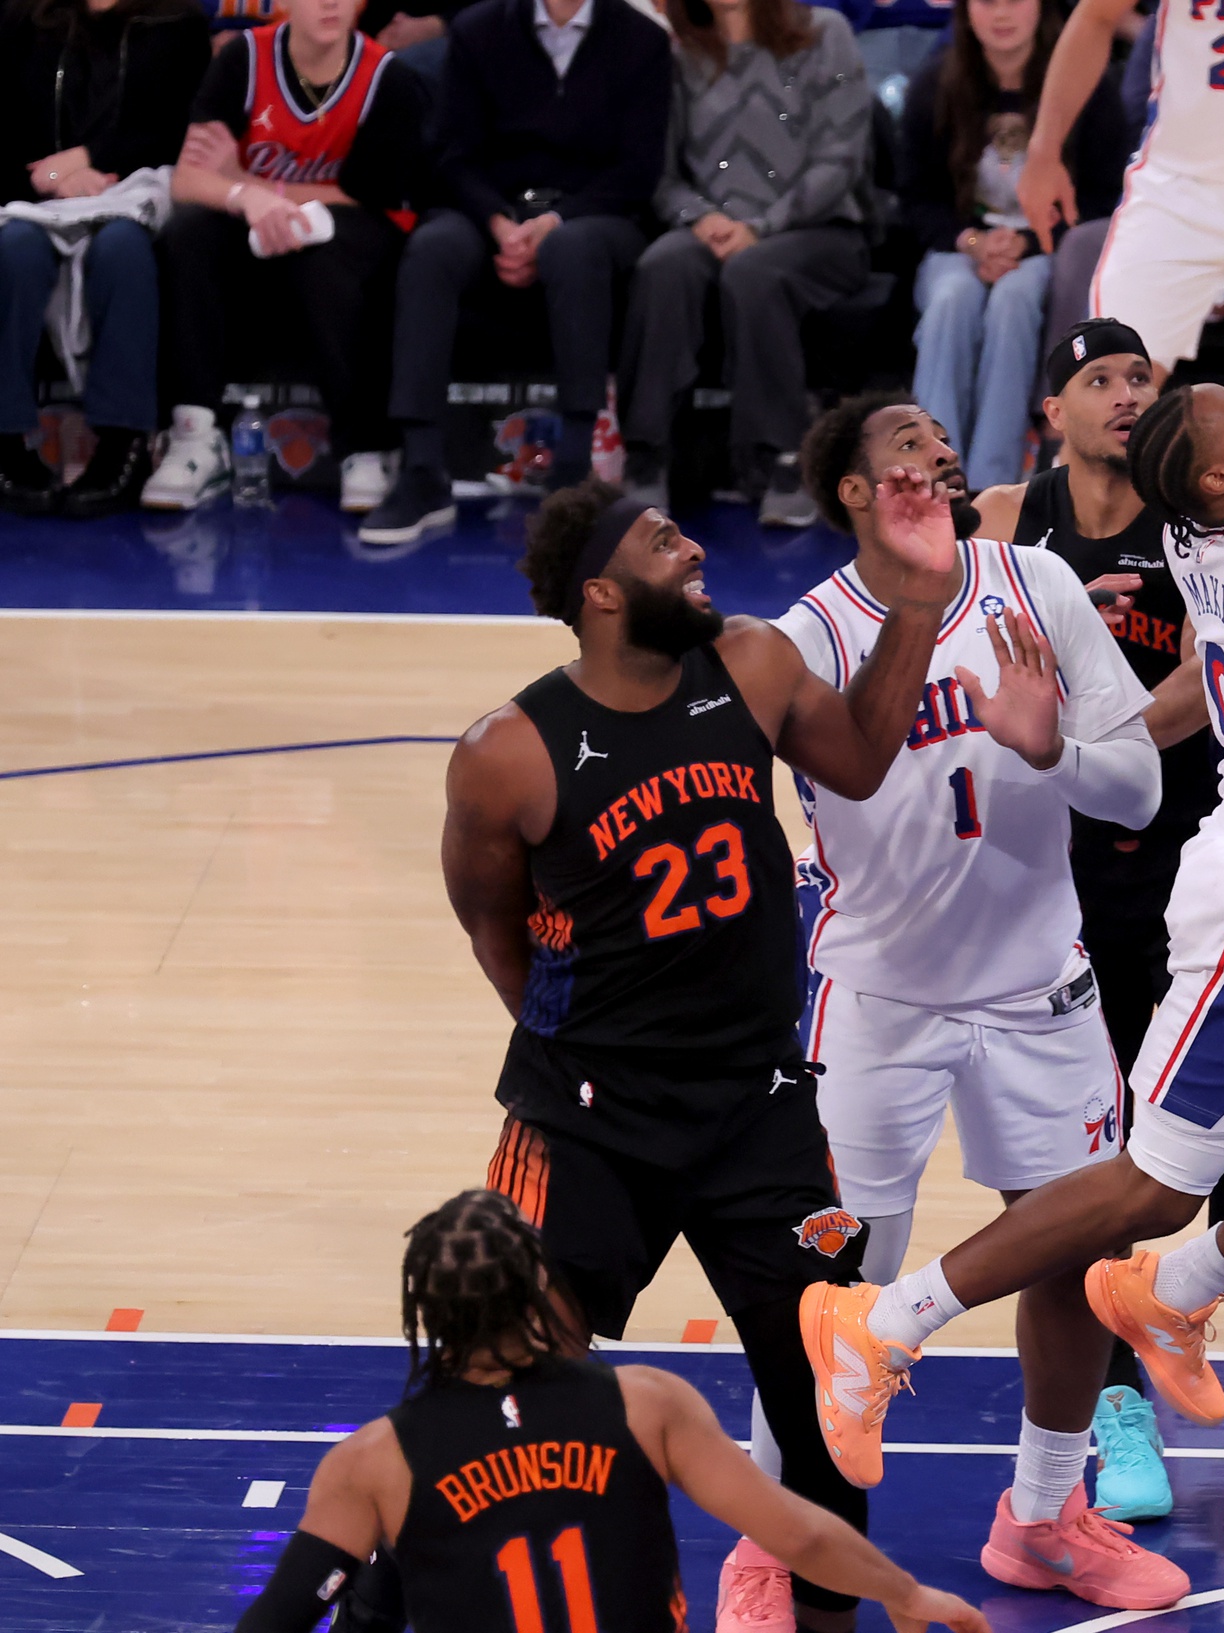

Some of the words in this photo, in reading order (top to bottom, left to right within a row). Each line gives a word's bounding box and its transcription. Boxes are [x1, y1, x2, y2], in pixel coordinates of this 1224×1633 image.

[589, 776, 664, 861] NEW
[662, 761, 761, 804] YORK
[949, 767, 982, 840] 1
[633, 820, 752, 940] 23
[1084, 1104, 1117, 1155] 76
[802, 1209, 860, 1243] KNICKS
[435, 1441, 618, 1523] BRUNSON
[496, 1527, 599, 1633] 11
